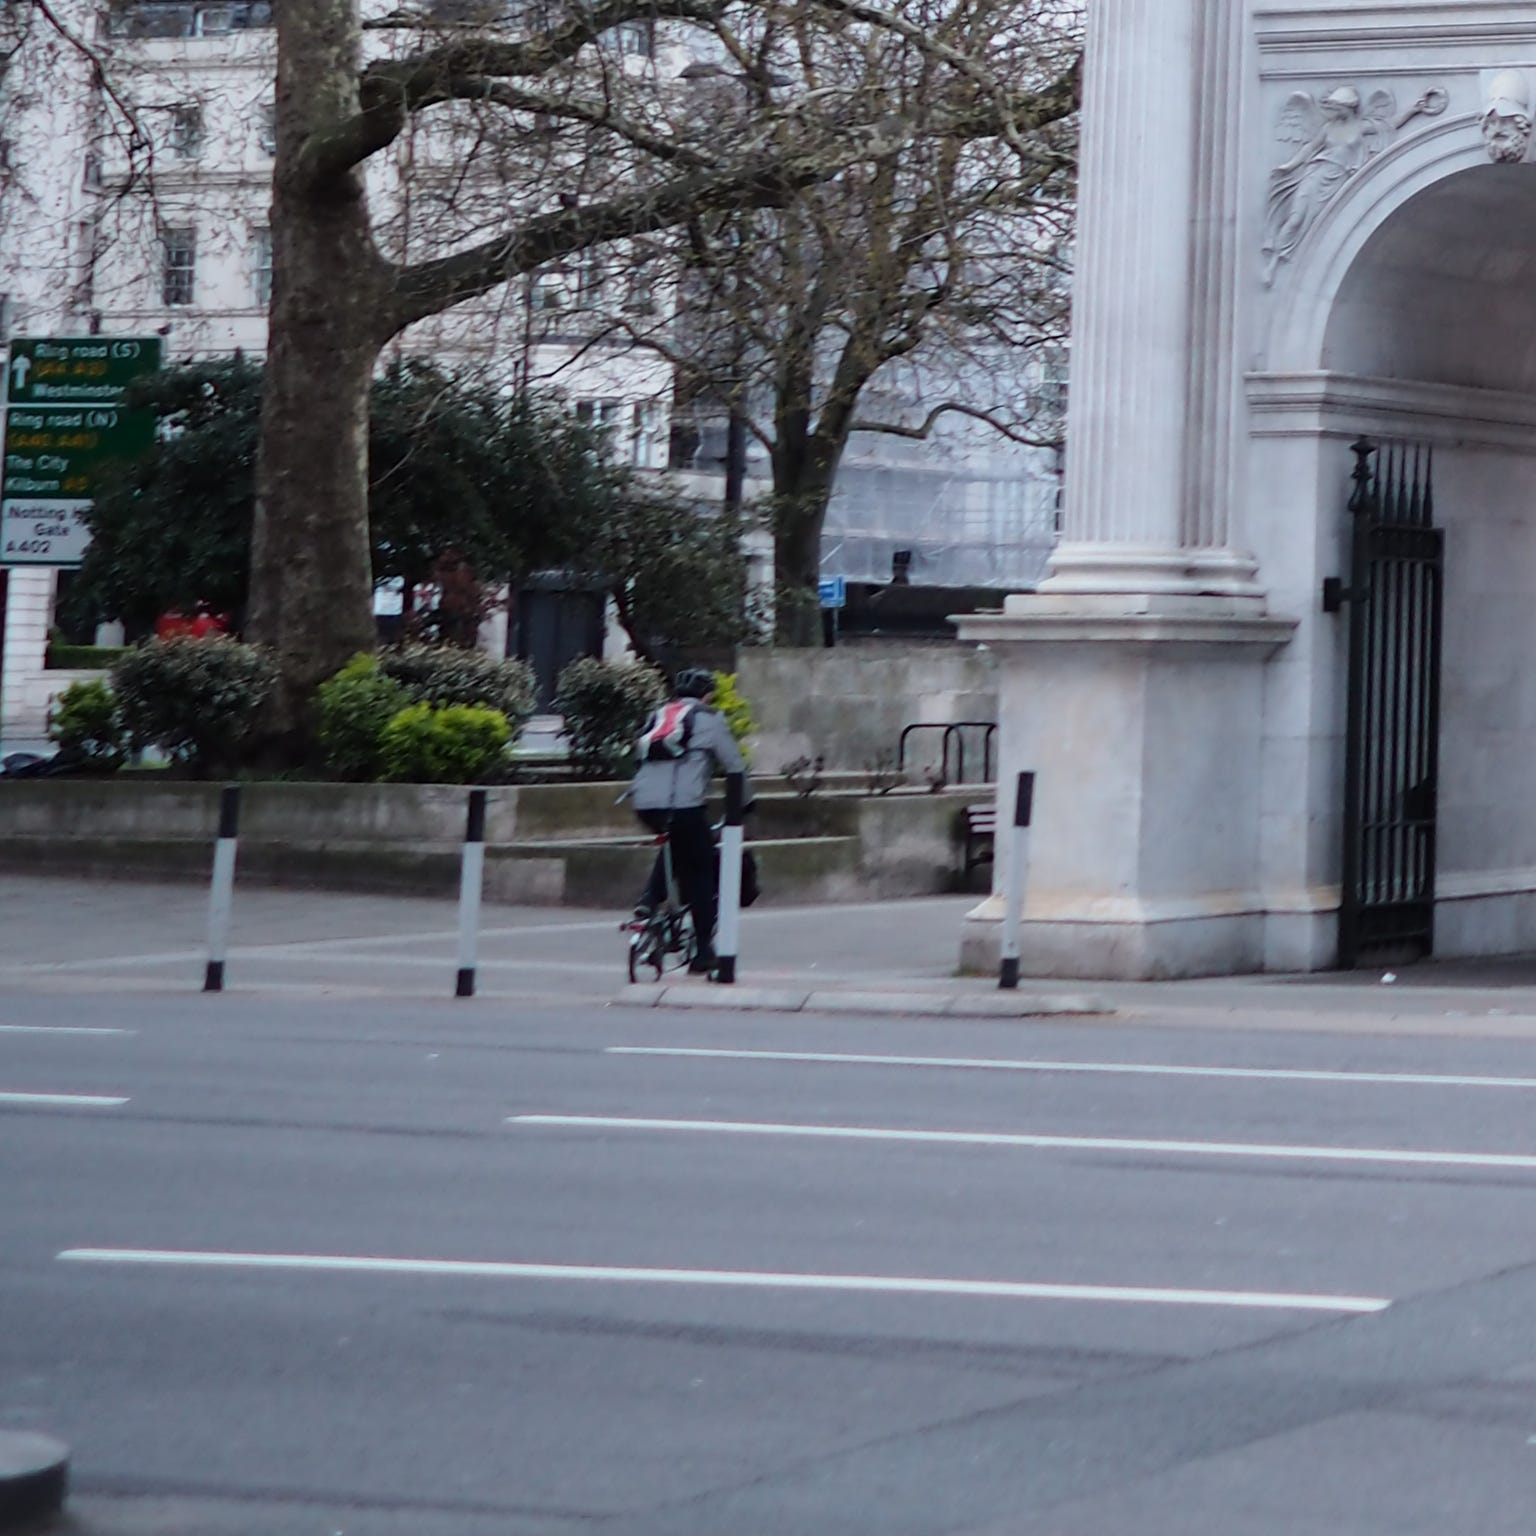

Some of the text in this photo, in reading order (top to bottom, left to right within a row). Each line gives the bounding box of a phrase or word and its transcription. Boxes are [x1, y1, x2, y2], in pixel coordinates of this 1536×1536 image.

[35, 341, 140, 360] Ring road (S)
[9, 410, 118, 429] Ring road (N)
[36, 454, 69, 472] City
[6, 477, 60, 492] Kilburn
[9, 506, 66, 521] Notting
[34, 523, 70, 536] Gate
